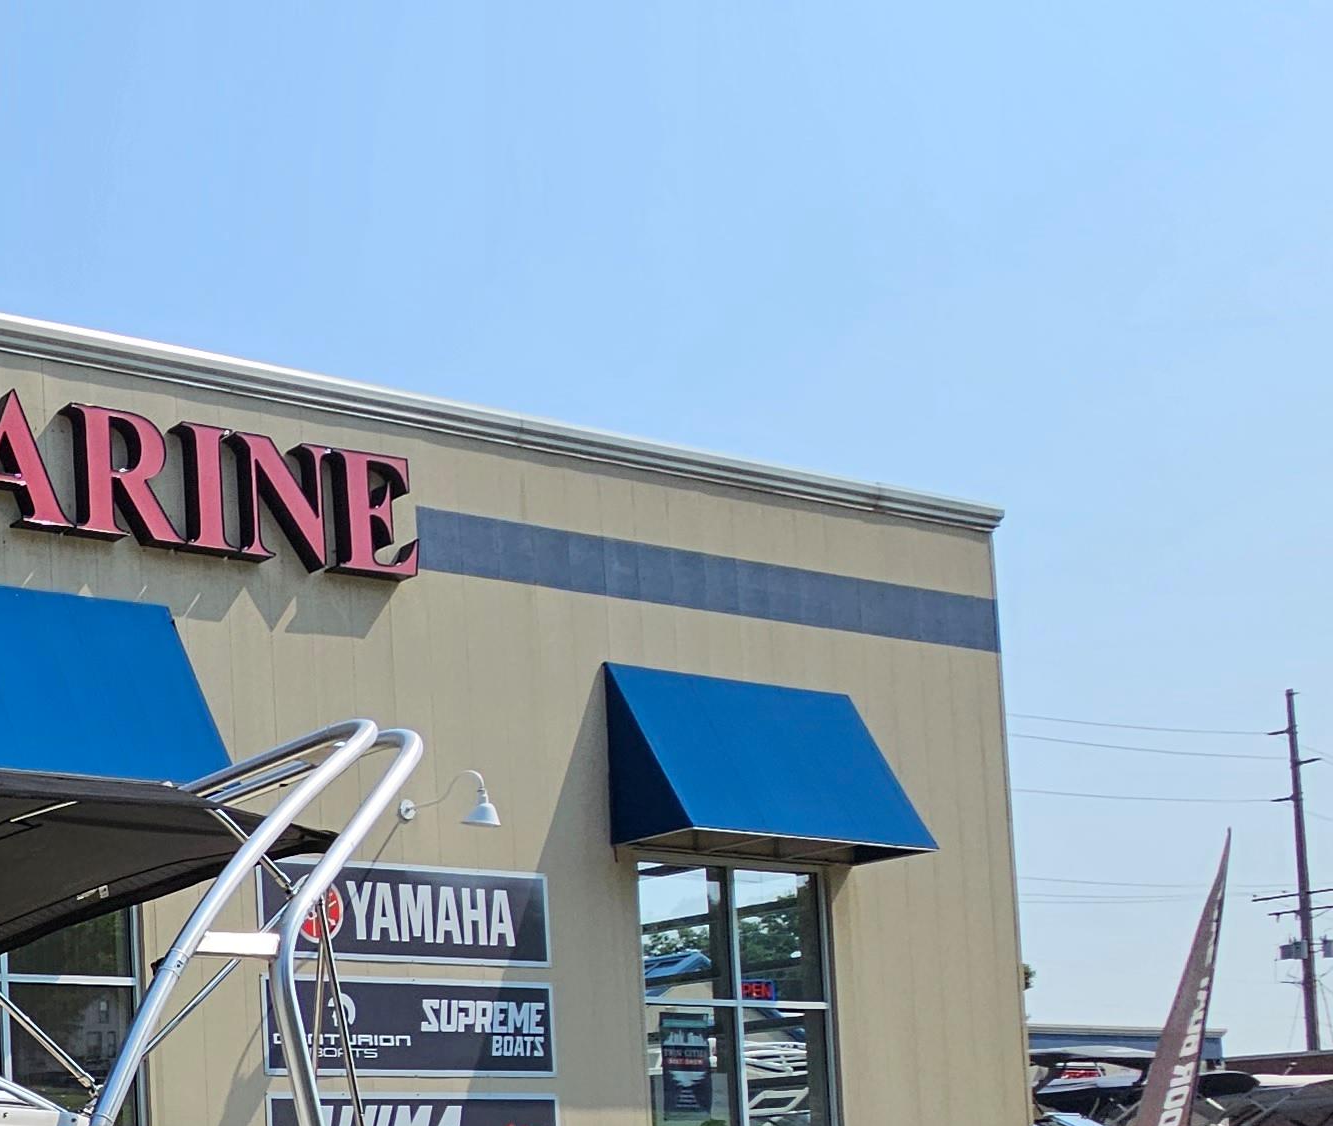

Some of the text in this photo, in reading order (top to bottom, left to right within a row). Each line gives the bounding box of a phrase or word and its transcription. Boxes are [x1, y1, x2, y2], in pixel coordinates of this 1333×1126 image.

[346, 880, 516, 947] YAMAHA
[741, 983, 773, 998] PEN
[421, 999, 545, 1034] SUPREME
[273, 1034, 411, 1046] CNTURION
[492, 1036, 544, 1057] BOATS
